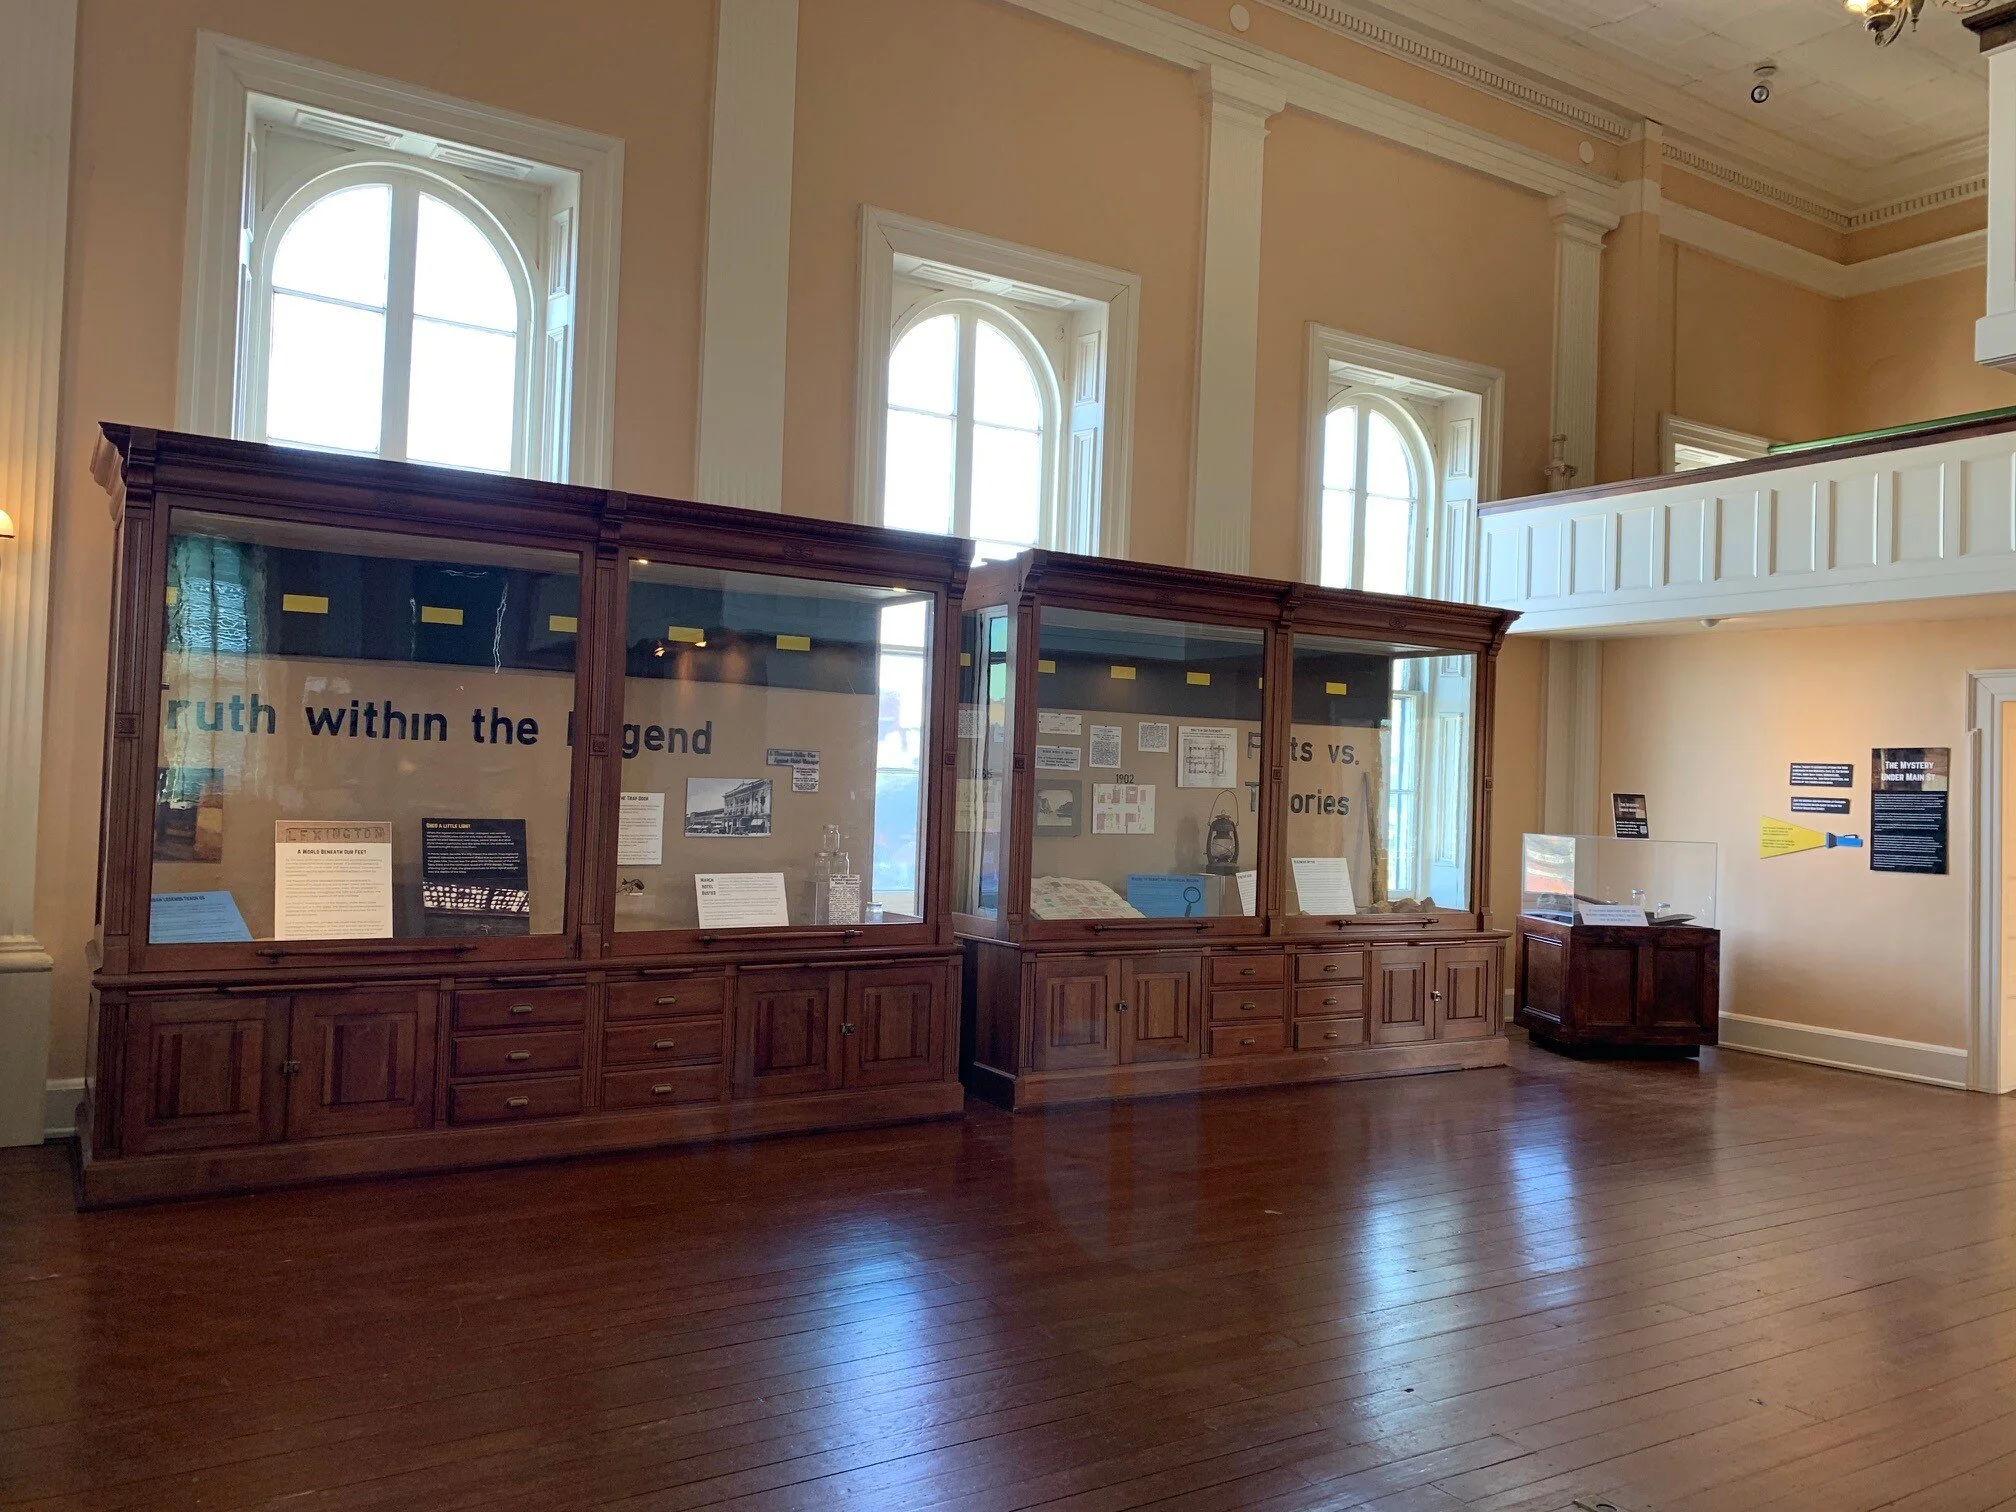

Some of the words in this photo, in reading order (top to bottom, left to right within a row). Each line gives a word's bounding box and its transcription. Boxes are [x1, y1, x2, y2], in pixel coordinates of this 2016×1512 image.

[163, 684, 275, 734] ruth
[305, 700, 447, 742] within
[472, 707, 539, 745] the
[1248, 731, 1313, 762] Fts
[1328, 744, 1359, 765] vs.
[1885, 761, 1899, 769] THE
[1900, 761, 1935, 769] MYSTERY
[1116, 774, 1134, 784] 1902
[1881, 773, 1904, 781] UNDER
[1906, 773, 1925, 781] MAIN
[1245, 782, 1350, 816] Tories
[287, 827, 386, 841] LEXINGTON
